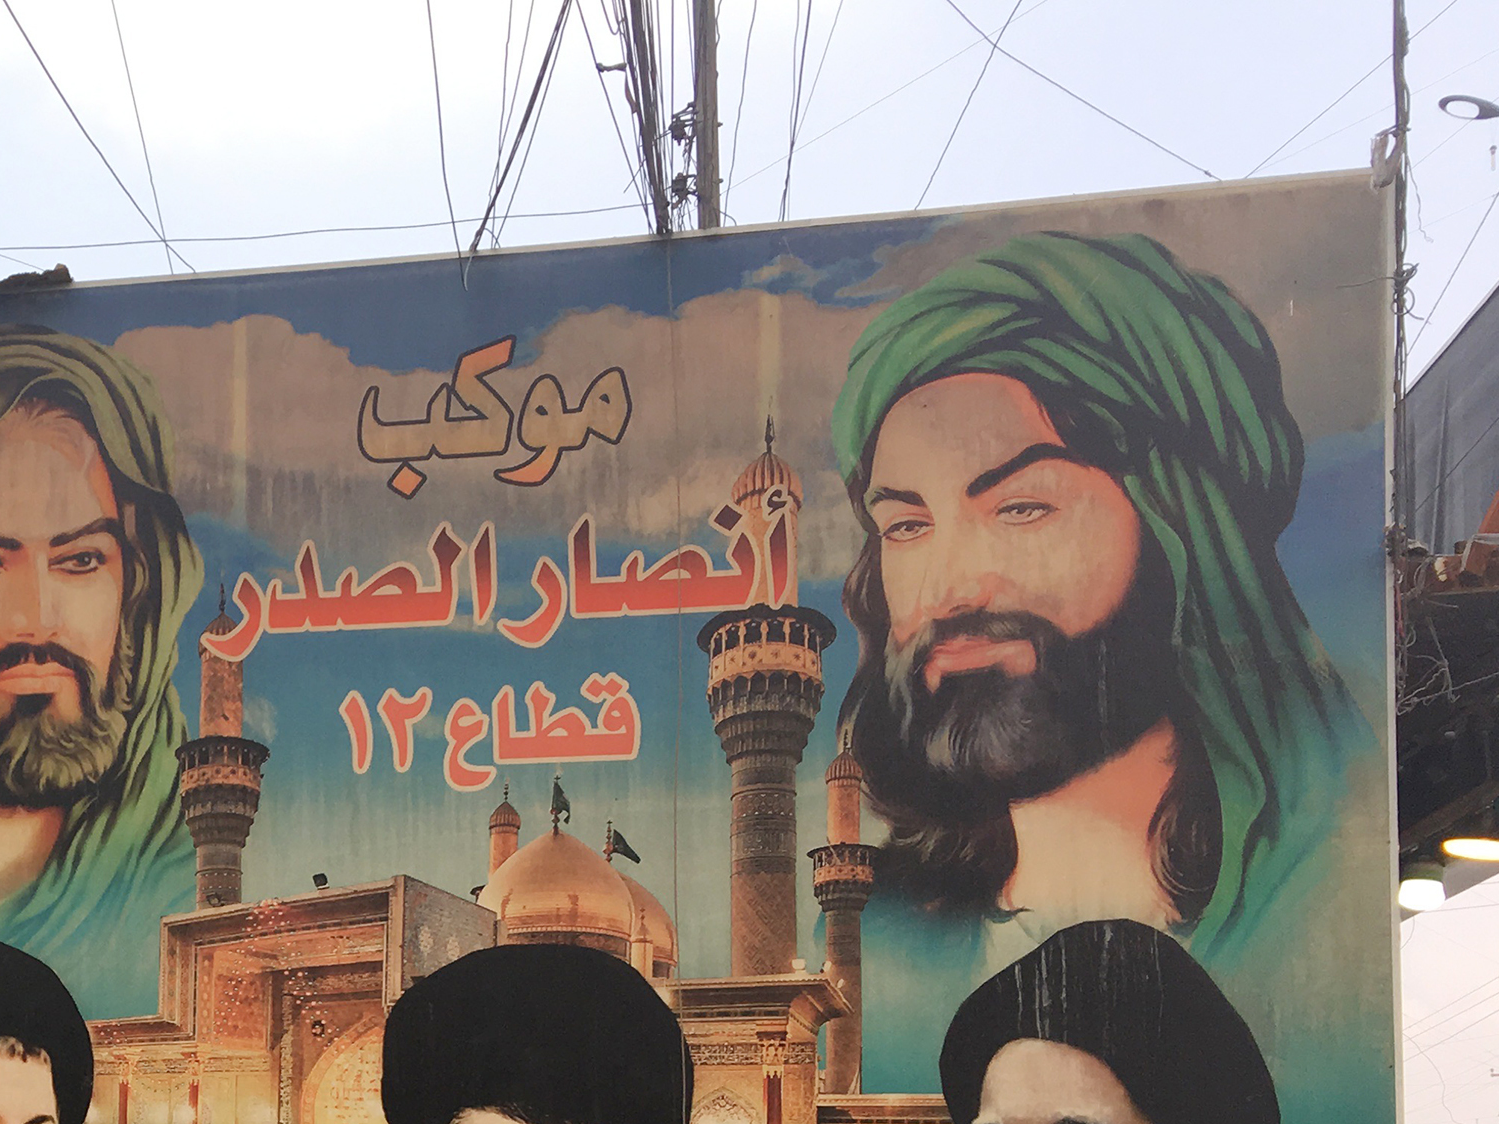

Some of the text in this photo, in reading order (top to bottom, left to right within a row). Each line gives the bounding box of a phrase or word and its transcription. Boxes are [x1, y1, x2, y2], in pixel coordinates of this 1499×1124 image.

[357, 334, 632, 500] موكب
[201, 484, 793, 662] أنصار الصدر
[443, 672, 641, 791] قطاع
